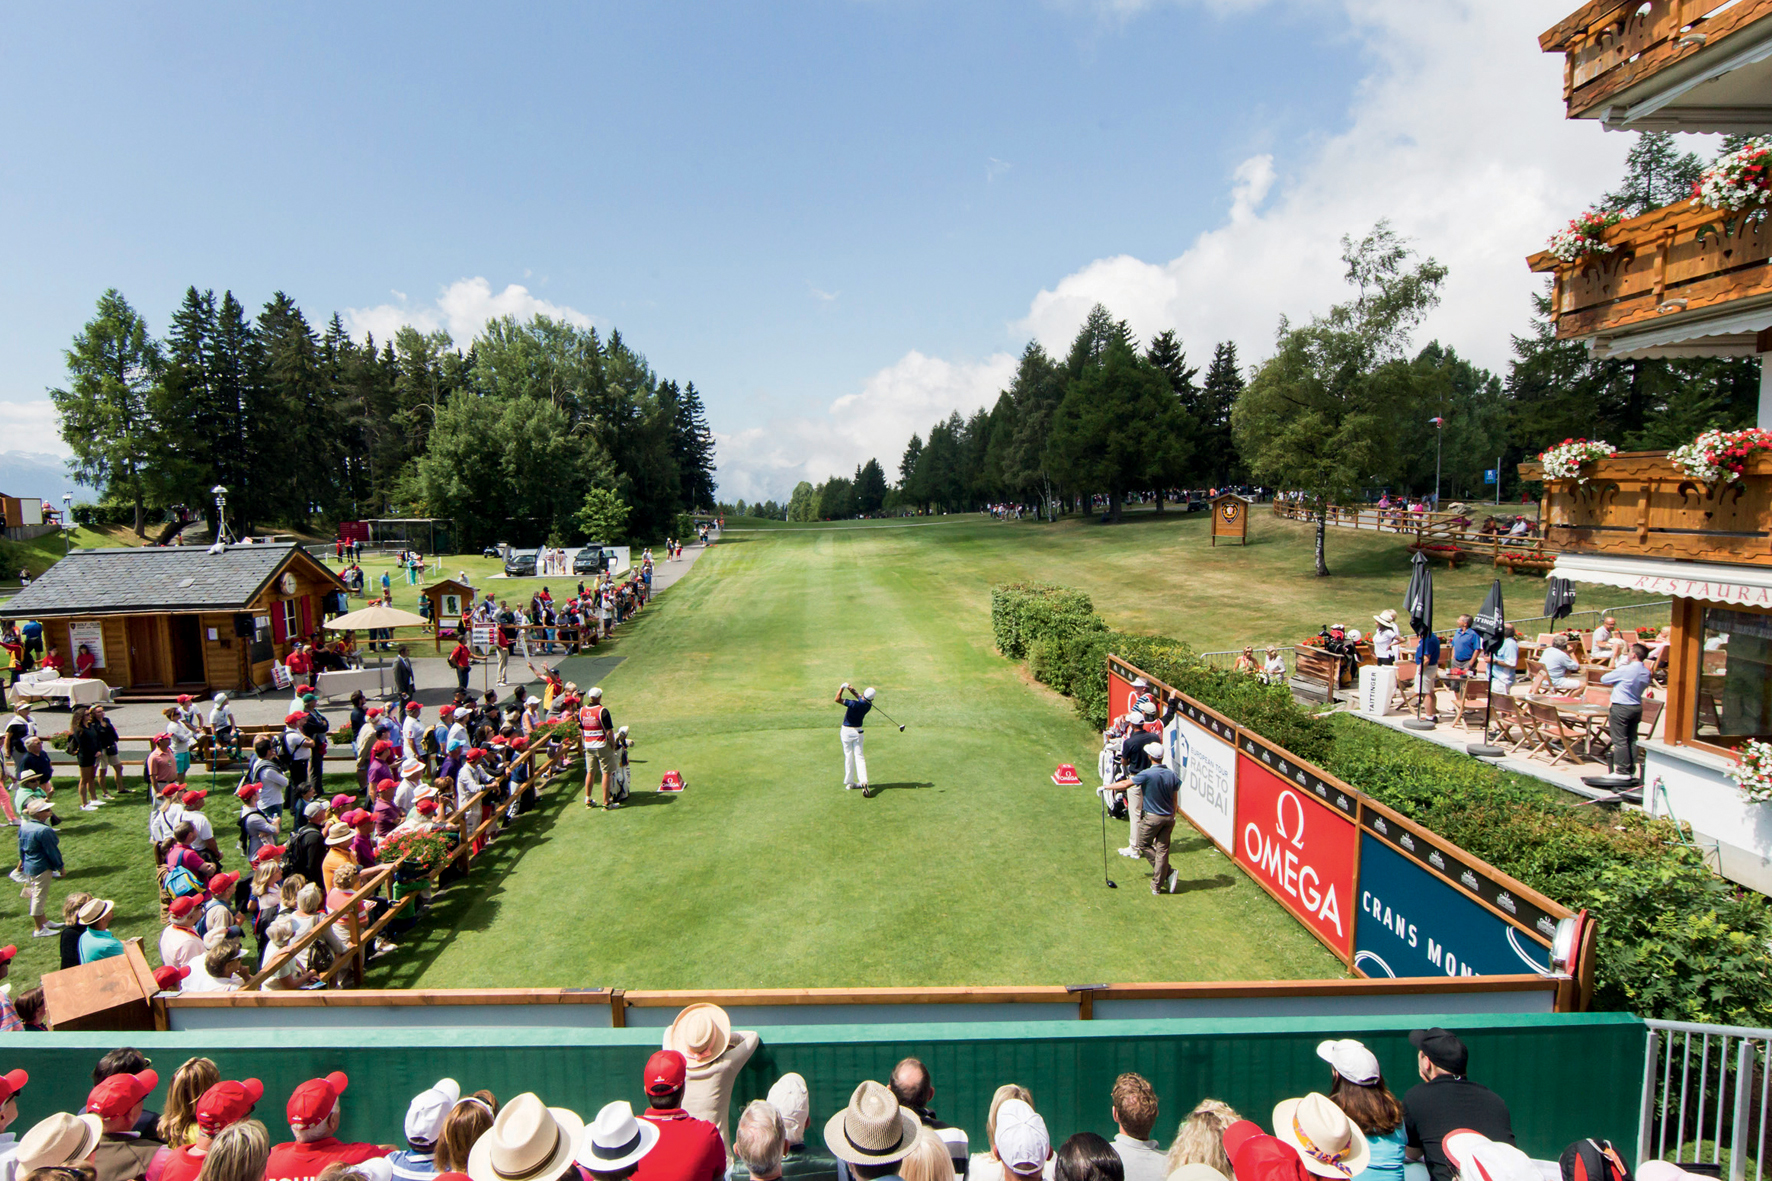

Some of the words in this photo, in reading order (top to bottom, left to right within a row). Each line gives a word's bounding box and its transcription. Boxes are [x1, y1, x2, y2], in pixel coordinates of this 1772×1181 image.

[1635, 576, 1769, 603] RESTAURA
[1190, 756, 1214, 783] RACE
[1216, 774, 1229, 794] TO
[1191, 746, 1214, 768] EUROPEAN
[1215, 763, 1229, 777] TOUR
[1190, 771, 1228, 816] DUBAI
[1244, 822, 1343, 938] OMEGA
[1362, 890, 1418, 948] CRANS
[1427, 937, 1480, 977] MON
